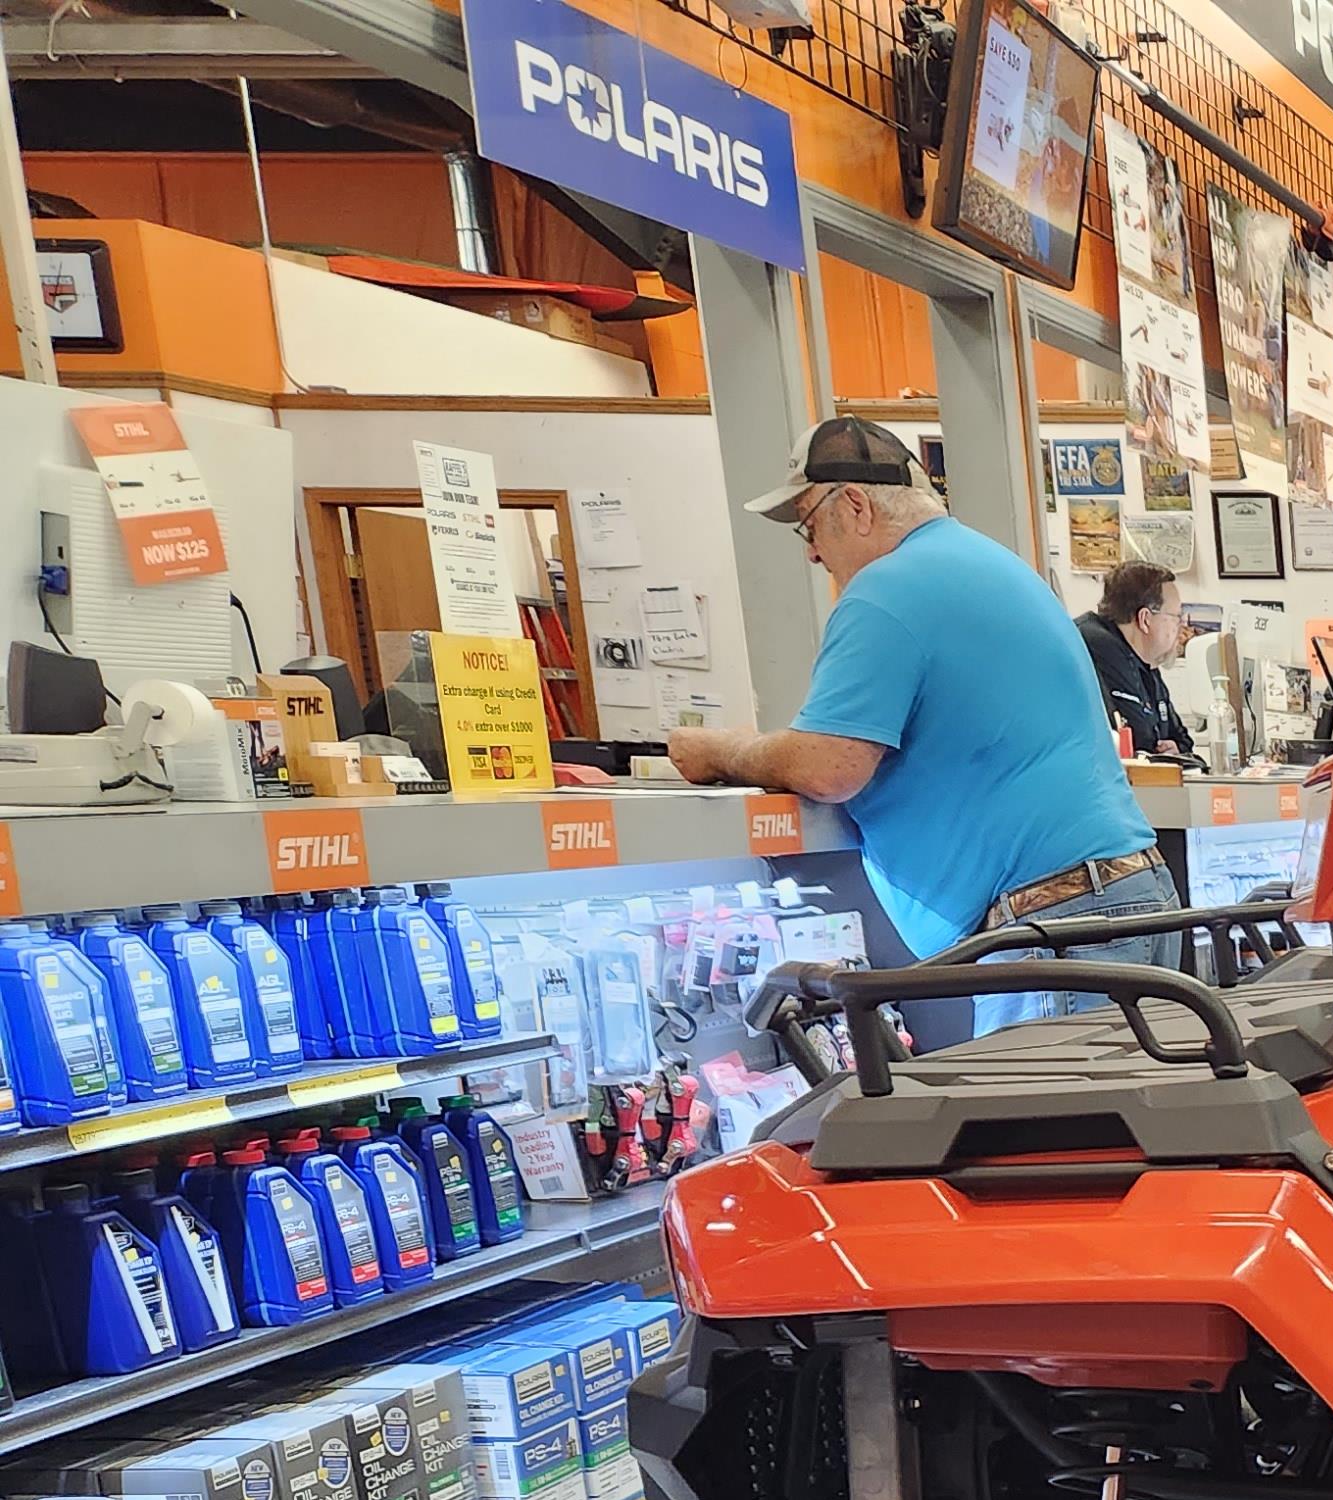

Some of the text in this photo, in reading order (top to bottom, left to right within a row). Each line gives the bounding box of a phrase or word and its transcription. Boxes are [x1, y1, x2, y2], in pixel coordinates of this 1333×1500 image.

[515, 39, 769, 207] POLARIS
[113, 422, 149, 438] STIHL
[1056, 445, 1092, 472] FFA
[142, 538, 210, 566] NOW $125
[462, 651, 510, 672] NOTICE!
[443, 684, 462, 697] Extra
[463, 686, 488, 700] charge
[495, 687, 514, 700] using
[515, 687, 537, 700] Credit
[484, 703, 502, 715] Card
[475, 722, 494, 732] extra
[495, 724, 510, 732] over
[511, 721, 534, 733] $1000
[235, 728, 250, 775] MotoMix
[752, 813, 797, 838] STIHL
[551, 822, 611, 850] STIHL
[277, 835, 359, 870] STIHL
[514, 1128, 551, 1144] Industry
[519, 1140, 556, 1156] Leading
[528, 1152, 554, 1165] 2 Year
[523, 1161, 566, 1178] Warranty
[582, 1346, 612, 1364] POLARIS
[516, 1369, 550, 1388] POLARIS
[588, 1413, 621, 1442] PS-4
[420, 1435, 441, 1449] OIL
[422, 1432, 471, 1462] CHANGE
[524, 1436, 563, 1466] PS-4
[361, 1462, 386, 1479] OIL
[364, 1458, 416, 1491] CHANGE
[424, 1456, 445, 1474] KIT
